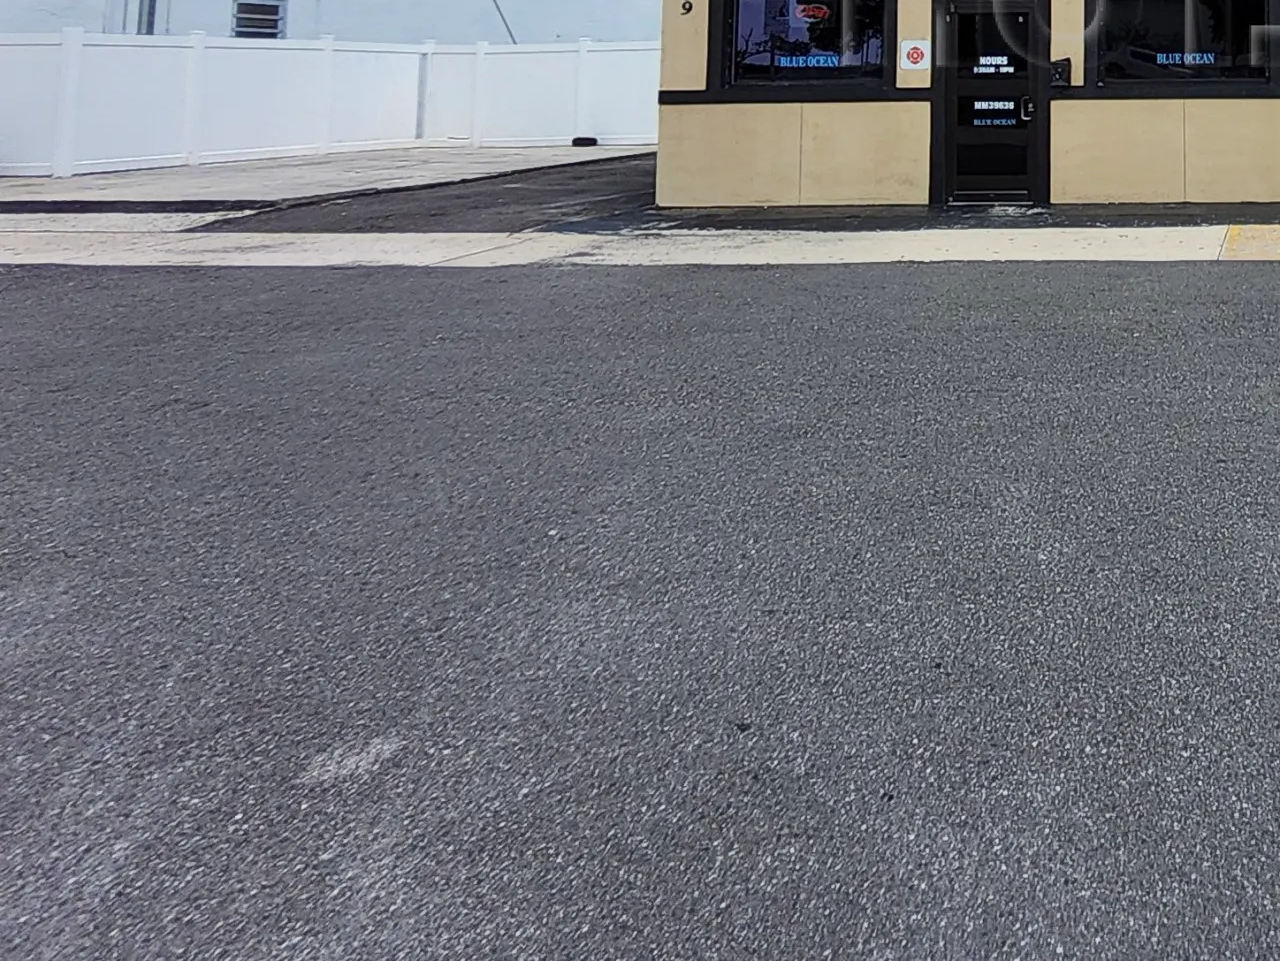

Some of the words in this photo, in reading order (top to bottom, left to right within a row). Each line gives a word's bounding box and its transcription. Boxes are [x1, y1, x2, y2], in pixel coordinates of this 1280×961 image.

[780, 56, 807, 67] BLUE
[807, 55, 840, 67] OCEAN
[979, 56, 1007, 66] HOURS
[1156, 53, 1182, 64] BLUE
[1183, 52, 1215, 64] OCEAN
